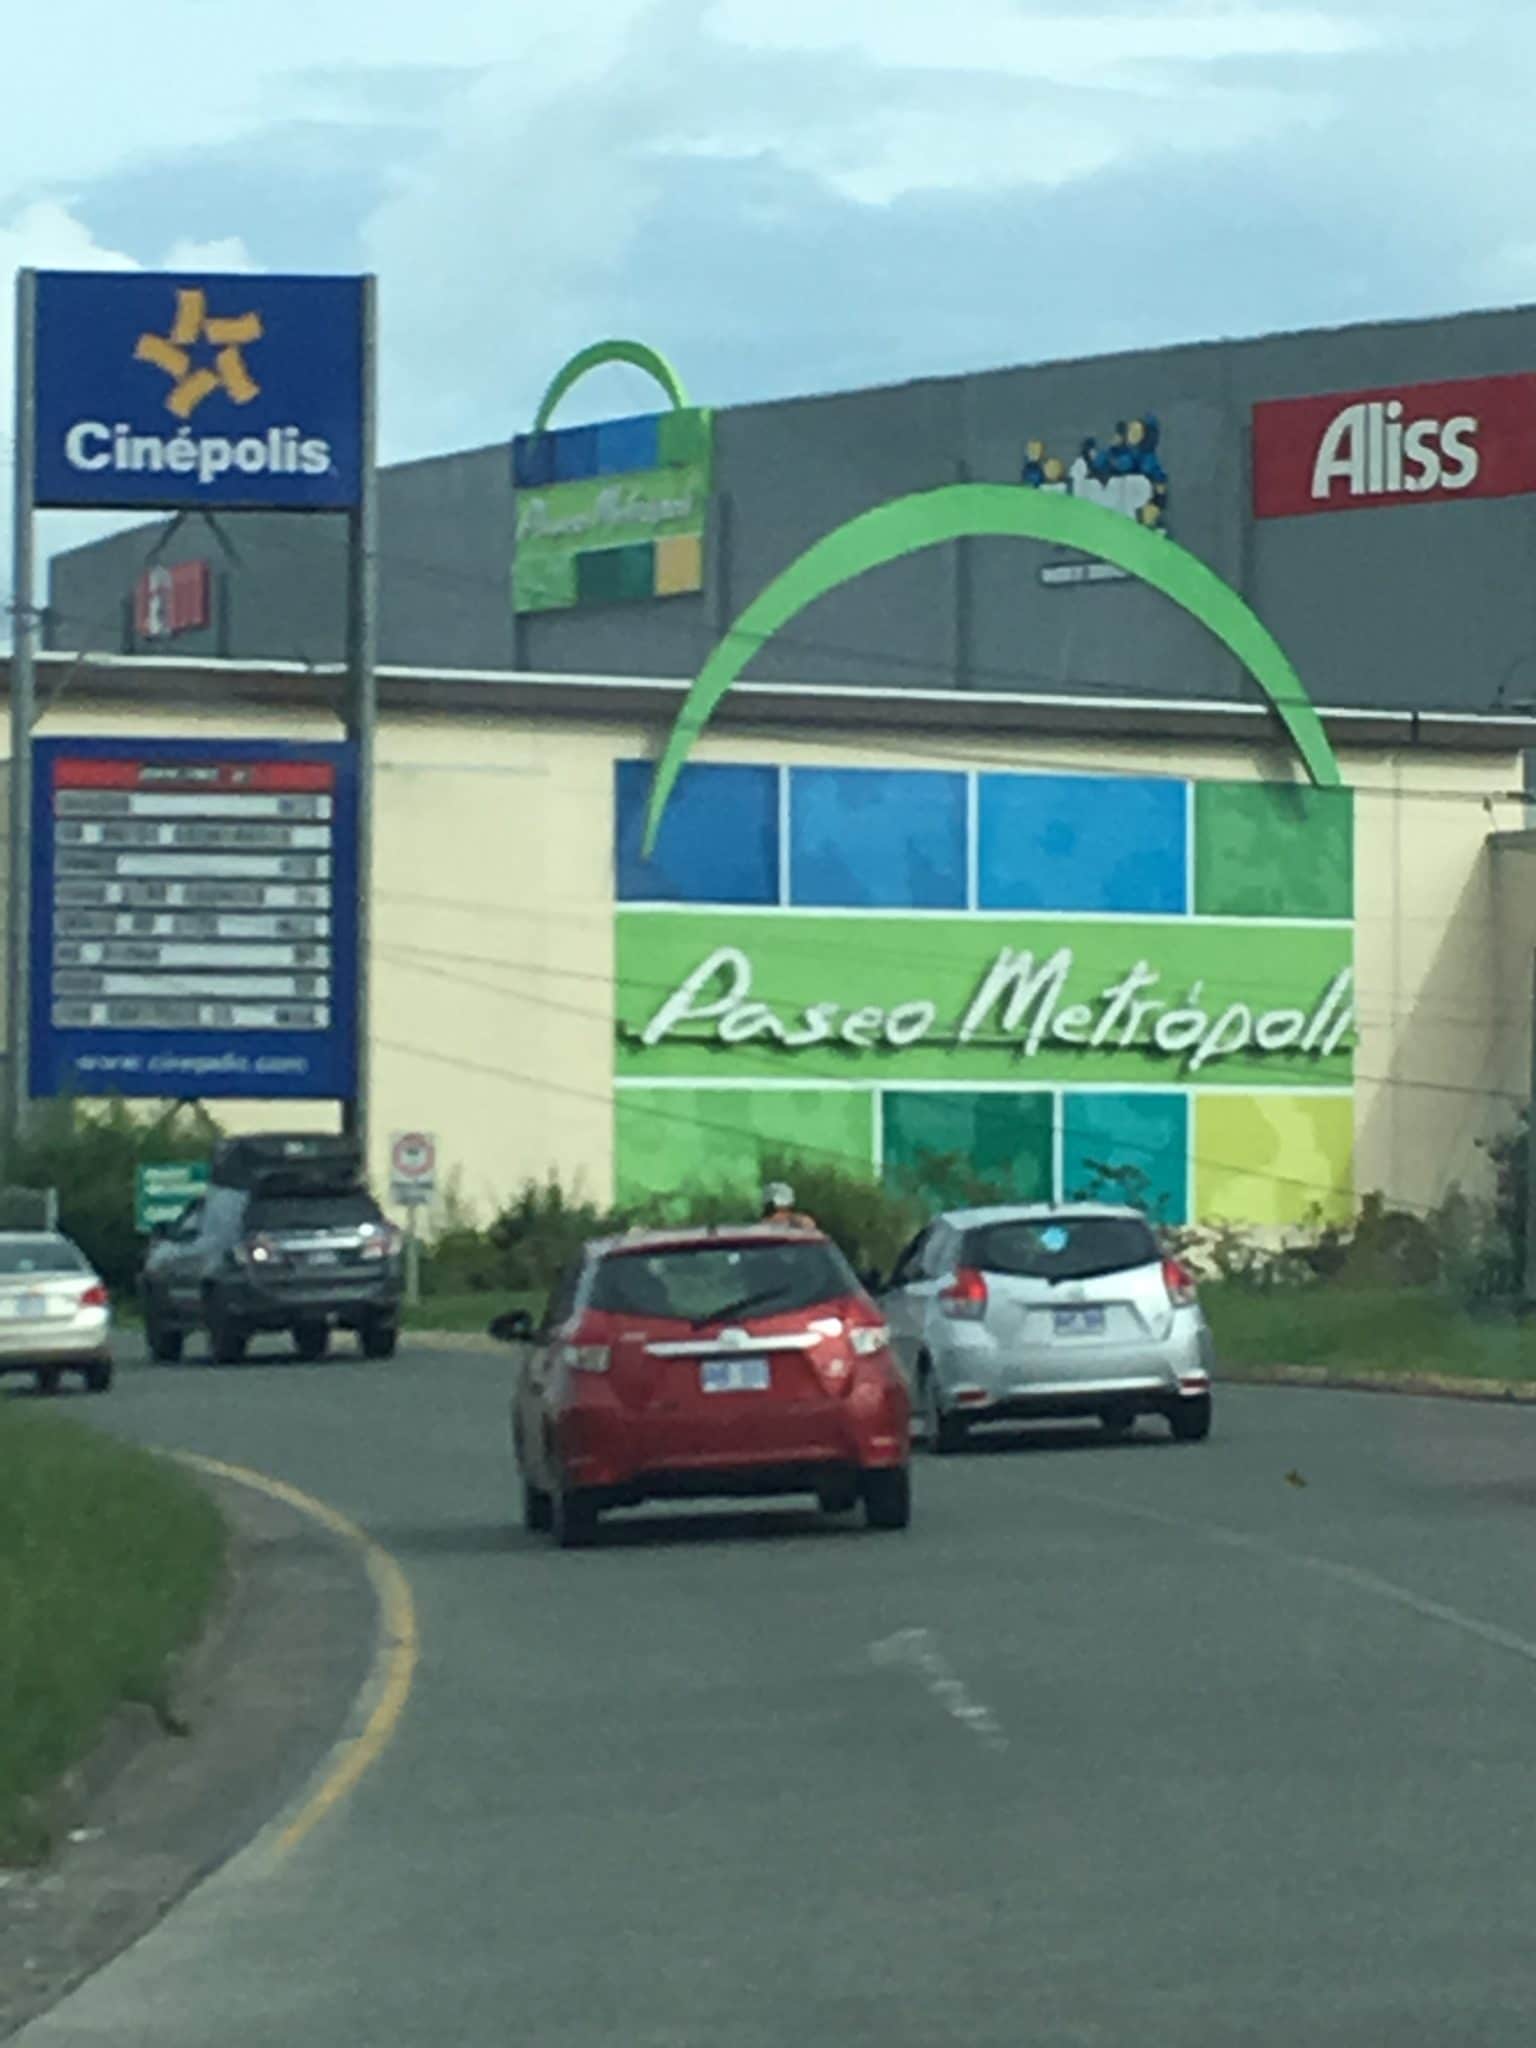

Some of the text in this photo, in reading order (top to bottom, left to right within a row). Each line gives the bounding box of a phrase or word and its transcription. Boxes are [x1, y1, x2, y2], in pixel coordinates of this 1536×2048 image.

[65, 421, 332, 484] Cinépolis
[1311, 400, 1479, 500] Aliss
[641, 946, 936, 1048] Paseo
